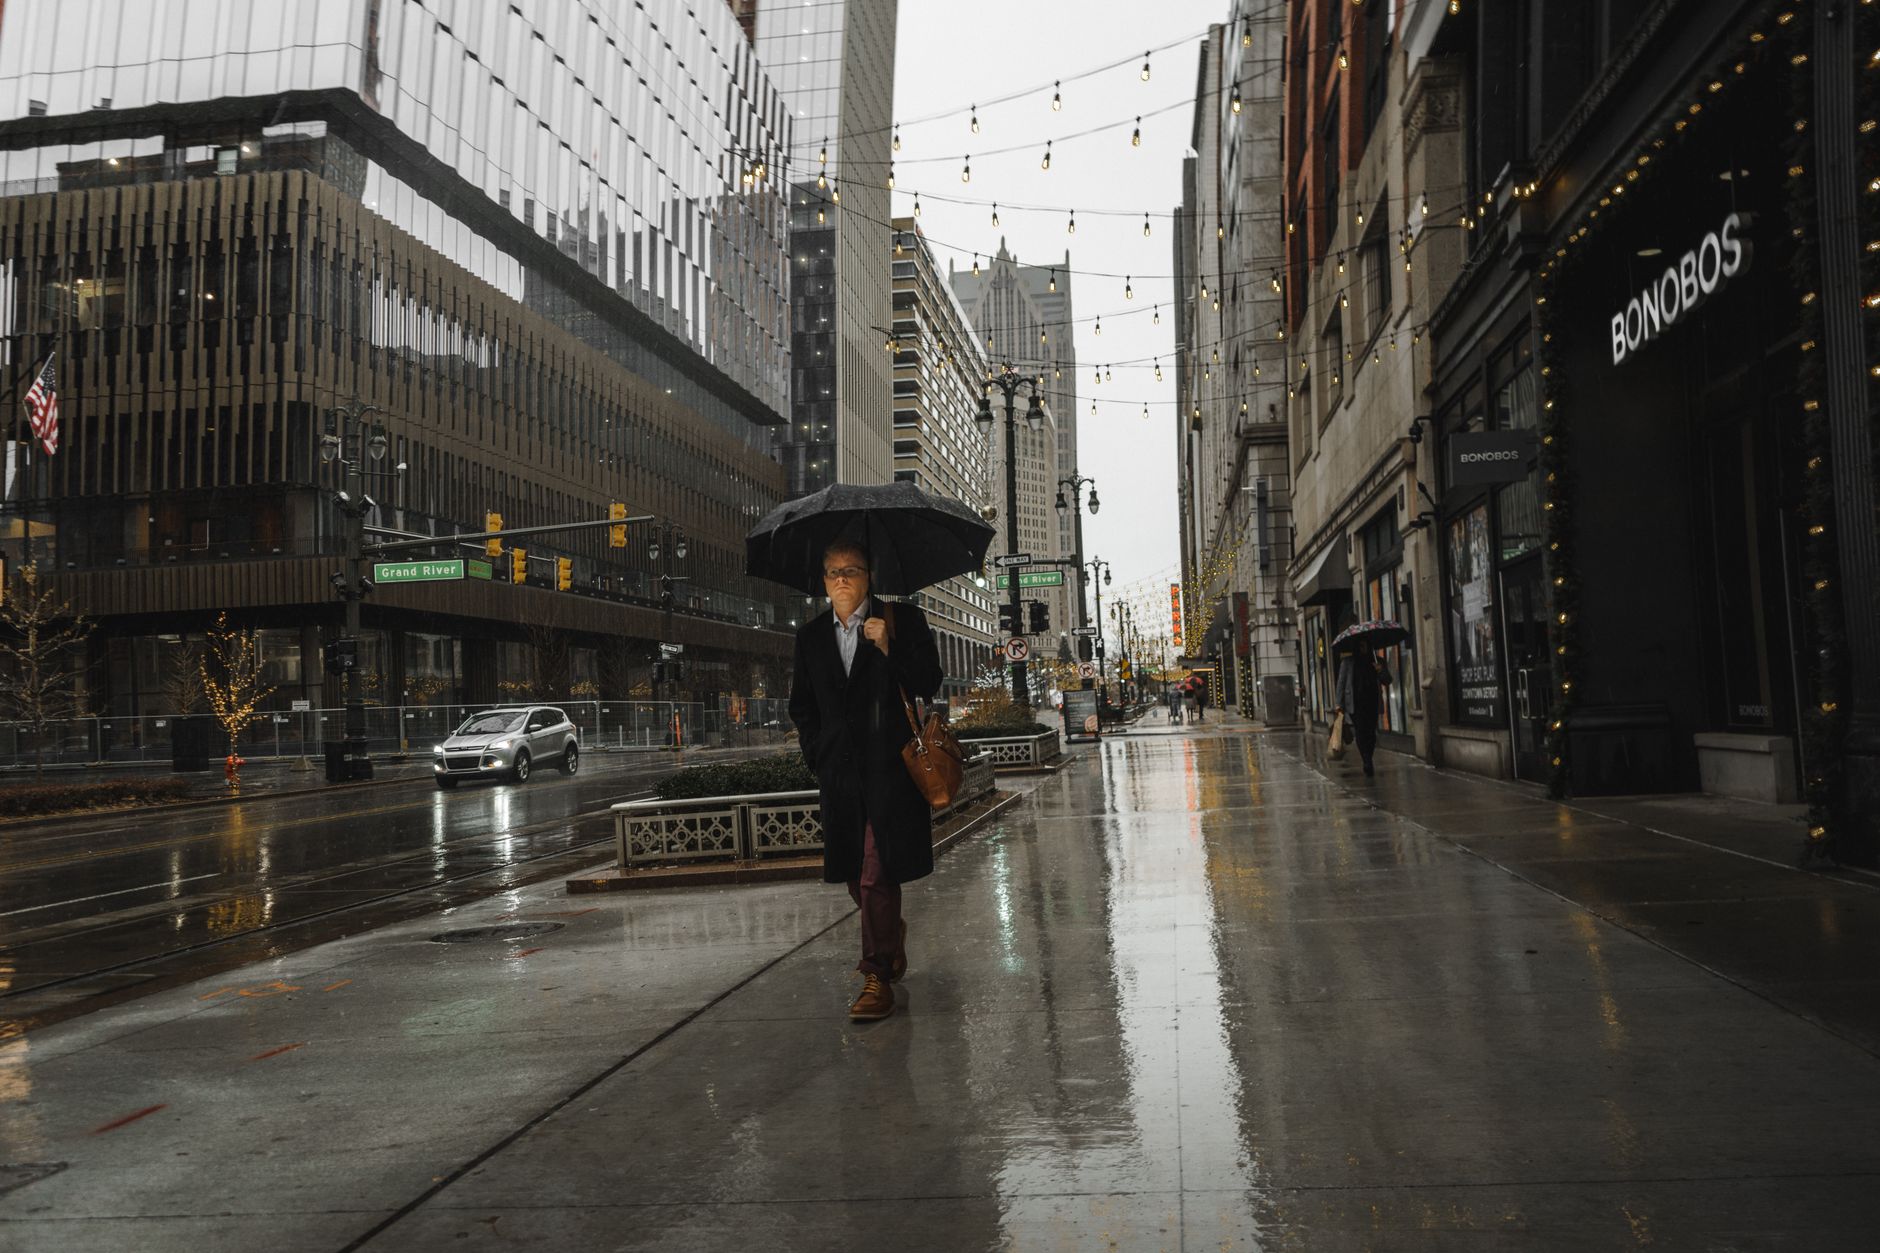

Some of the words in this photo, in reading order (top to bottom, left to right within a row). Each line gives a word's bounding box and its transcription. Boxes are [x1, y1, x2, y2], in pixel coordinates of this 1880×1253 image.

[1612, 213, 1741, 366] BONOBOS
[1460, 450, 1519, 463] BONOBOS
[381, 566, 417, 578] Grand
[422, 565, 456, 576] River
[1002, 576, 1028, 585] Gnd
[1031, 575, 1057, 584] River
[1171, 586, 1181, 634] PARK
[1462, 687, 1482, 699] DOWNTOWN
[1482, 686, 1498, 699] DETROIT
[1738, 704, 1769, 717] BONOBOS
